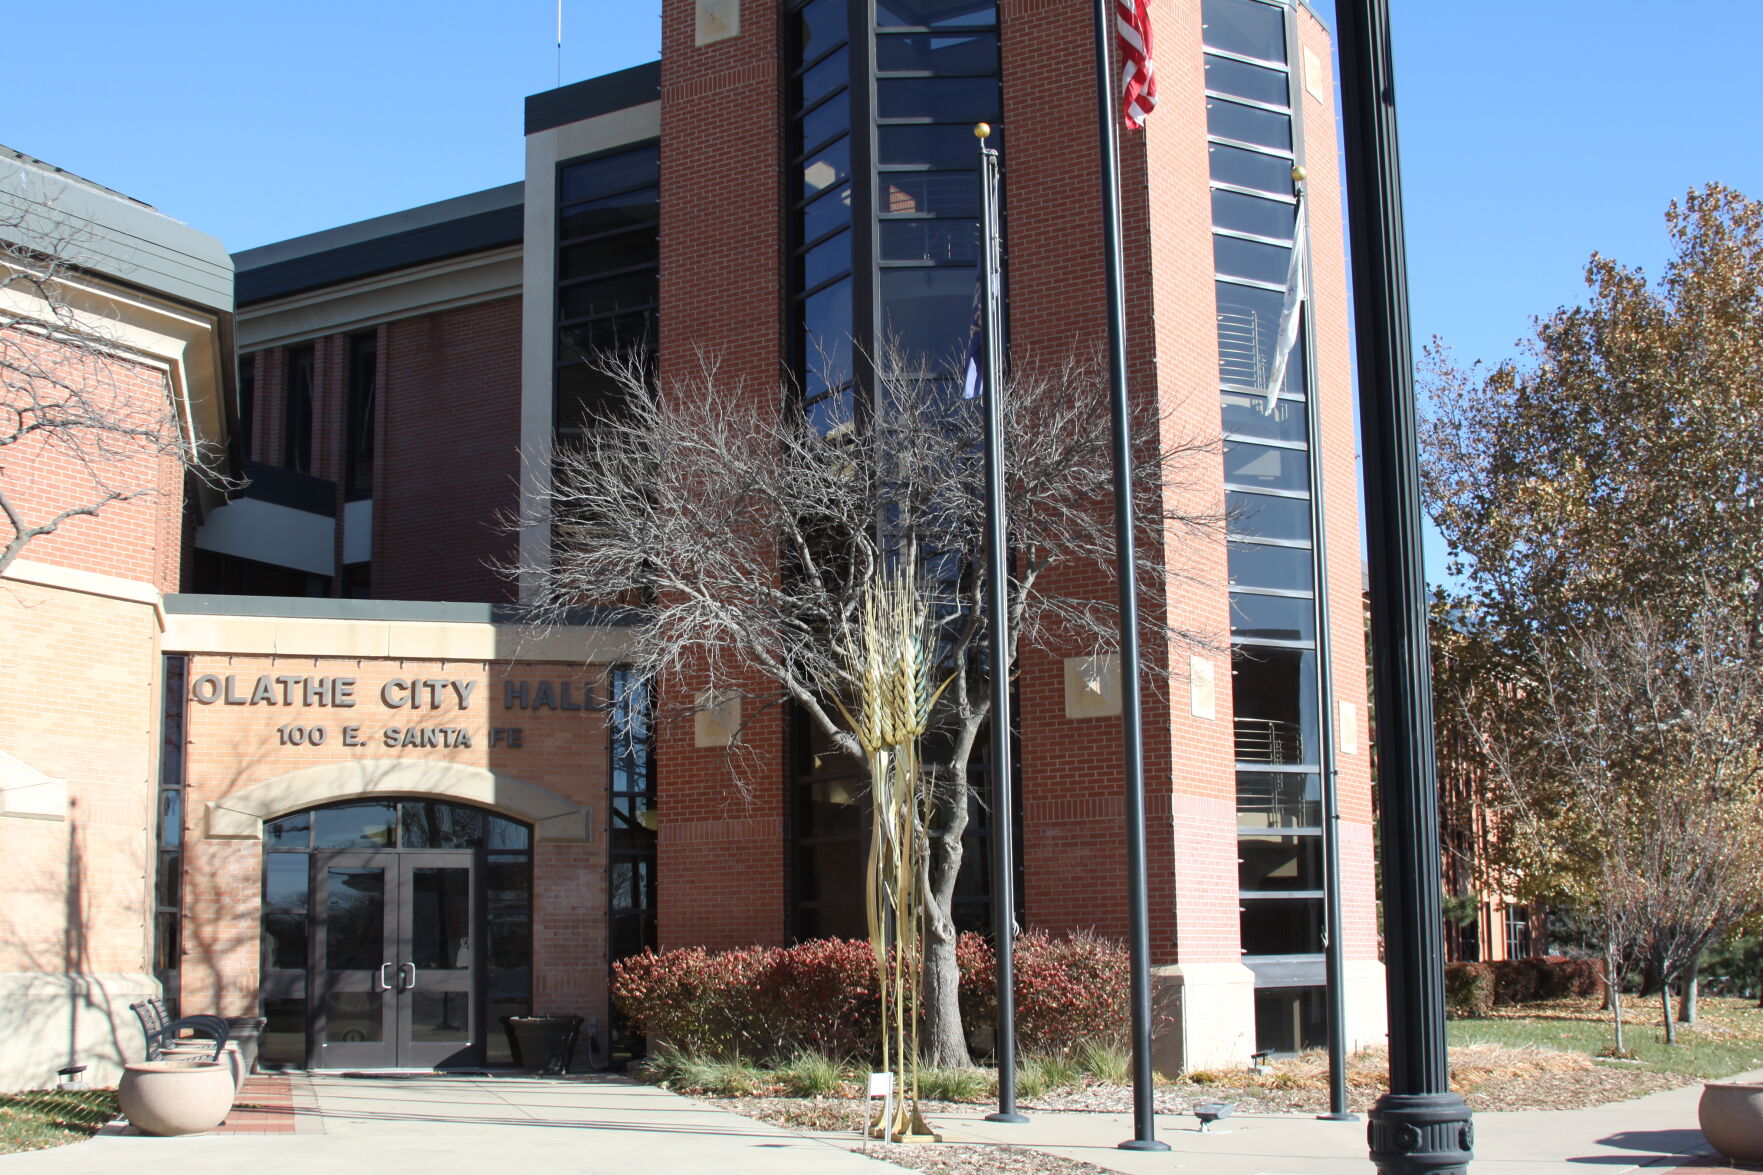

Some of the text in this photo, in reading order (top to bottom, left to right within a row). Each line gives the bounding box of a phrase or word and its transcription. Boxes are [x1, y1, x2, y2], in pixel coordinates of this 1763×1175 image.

[192, 674, 605, 711] OLATHE CITY HALL
[277, 725, 524, 749] 100 E. SANTA FE
